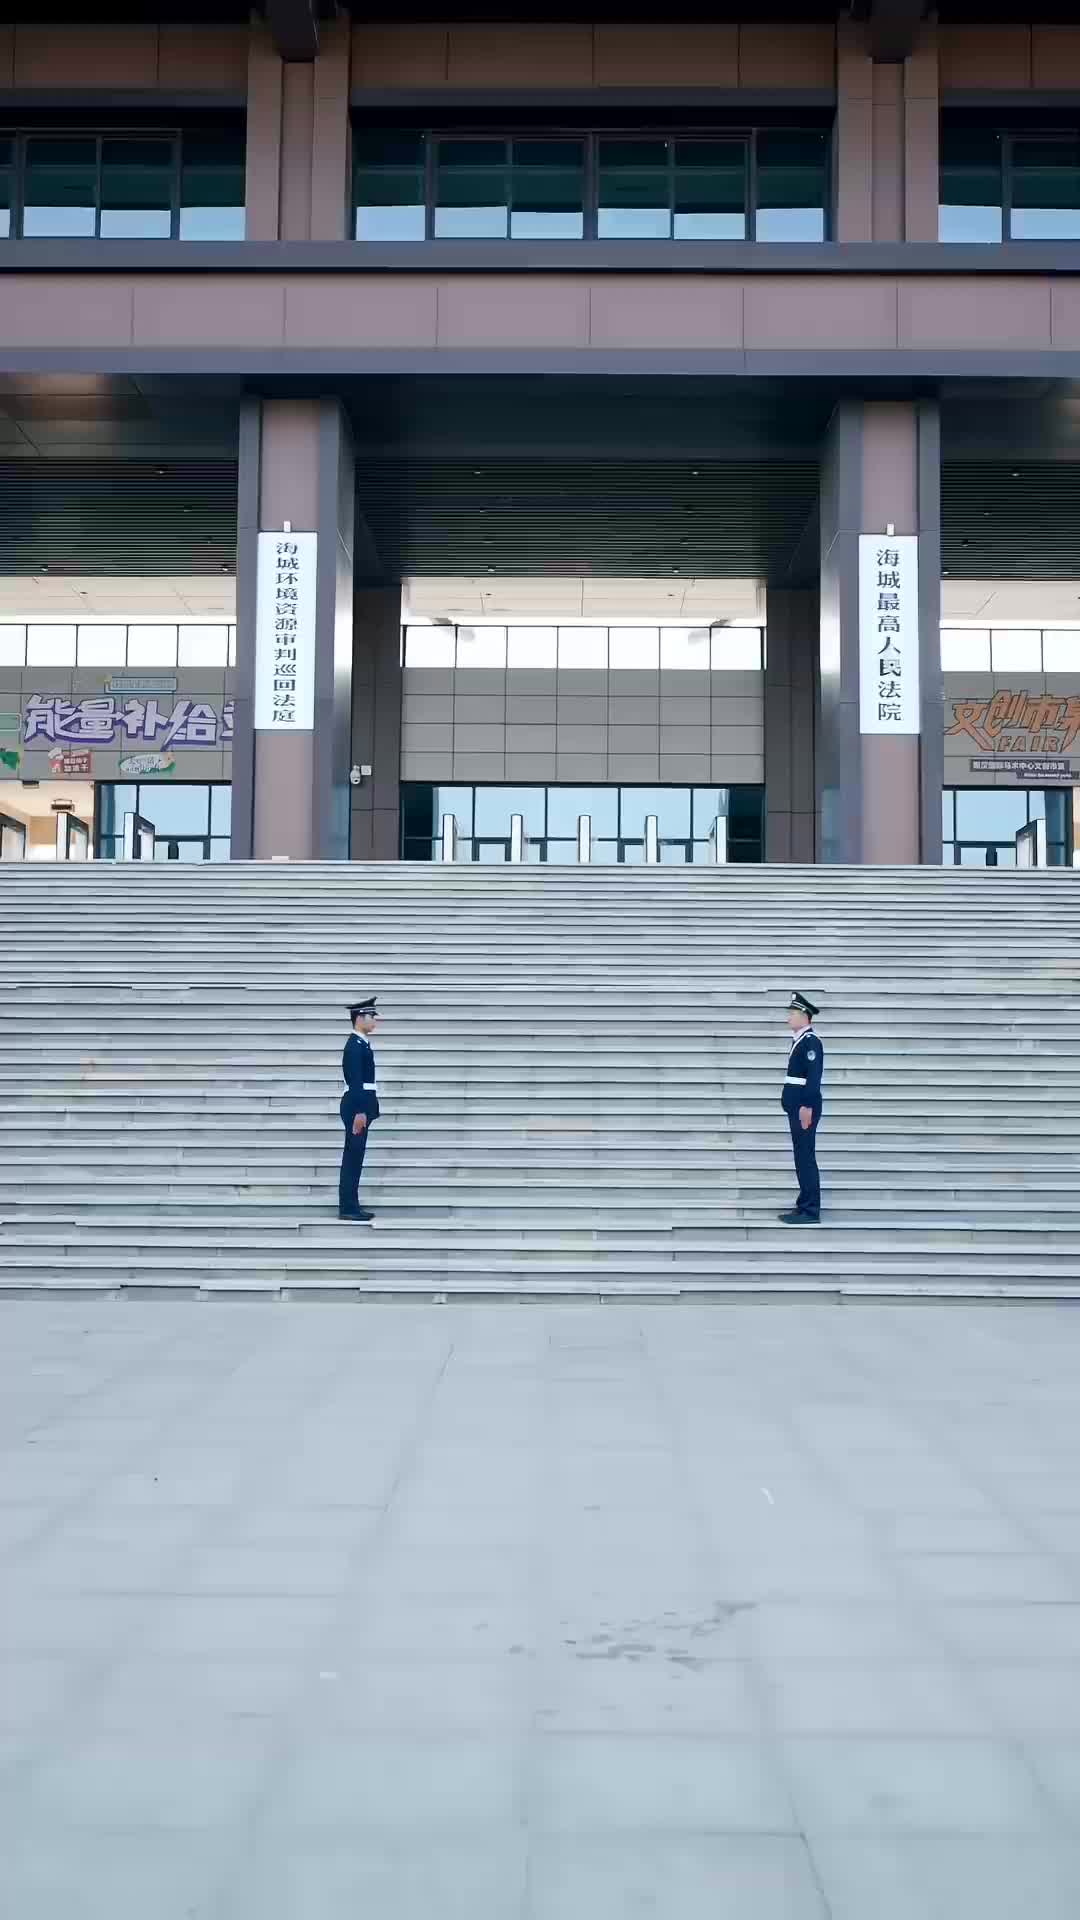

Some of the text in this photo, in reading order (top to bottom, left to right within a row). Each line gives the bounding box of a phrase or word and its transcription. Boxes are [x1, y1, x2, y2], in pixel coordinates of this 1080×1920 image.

[272, 542, 300, 723] 海城环境资源审判巡回法庭
[876, 548, 902, 722] 海城最高人民法院
[24, 693, 234, 751] 能量补给
[997, 736, 1060, 752] FAIR
